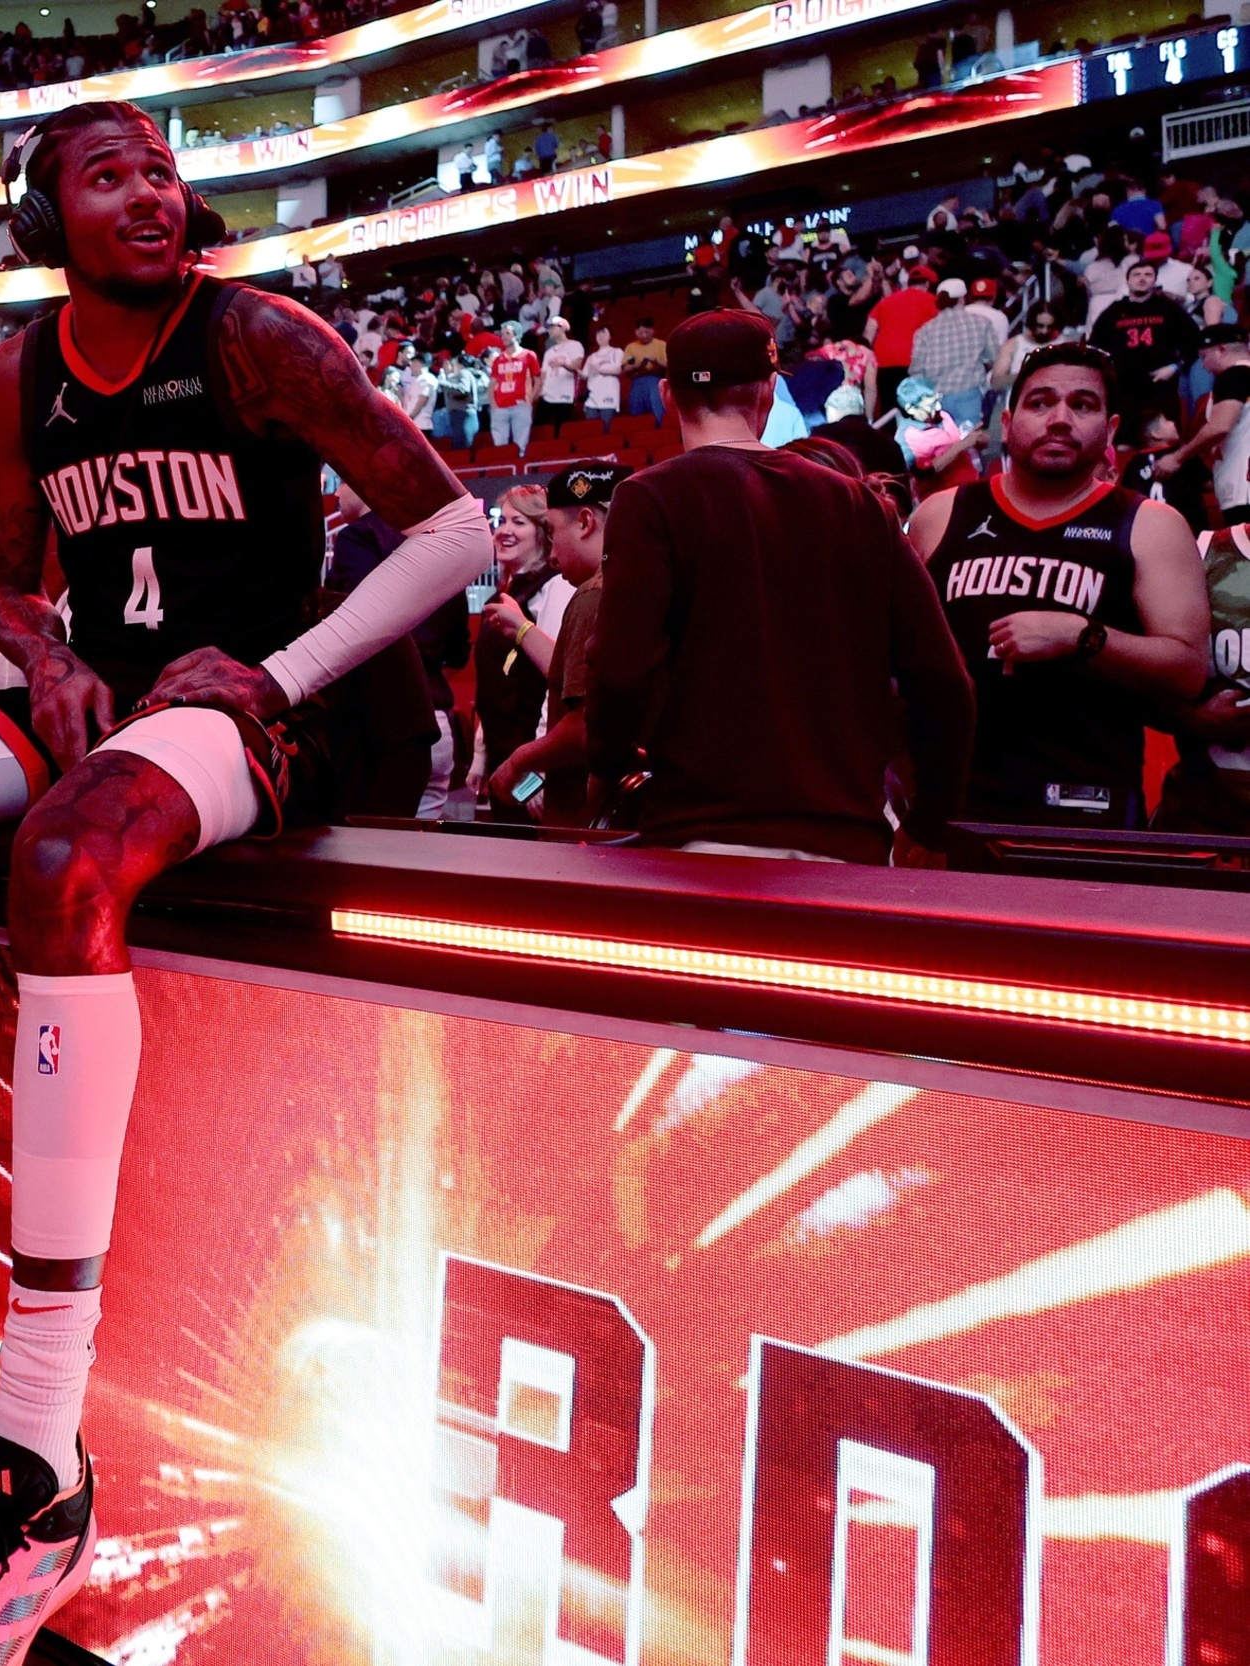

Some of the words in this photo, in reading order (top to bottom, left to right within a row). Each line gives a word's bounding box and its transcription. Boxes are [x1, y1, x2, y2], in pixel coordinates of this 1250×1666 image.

[29, 80, 82, 110] WIN
[1113, 69, 1127, 96] 1
[1165, 57, 1183, 85] 4
[1221, 46, 1235, 74] 1
[252, 128, 313, 166] WIN
[347, 188, 517, 254] ROCKETS
[533, 167, 614, 215] WIN
[1126, 327, 1153, 348] 34
[40, 449, 247, 536] HOUSTON
[123, 546, 164, 630] 4
[947, 556, 1105, 615] HOUSTON
